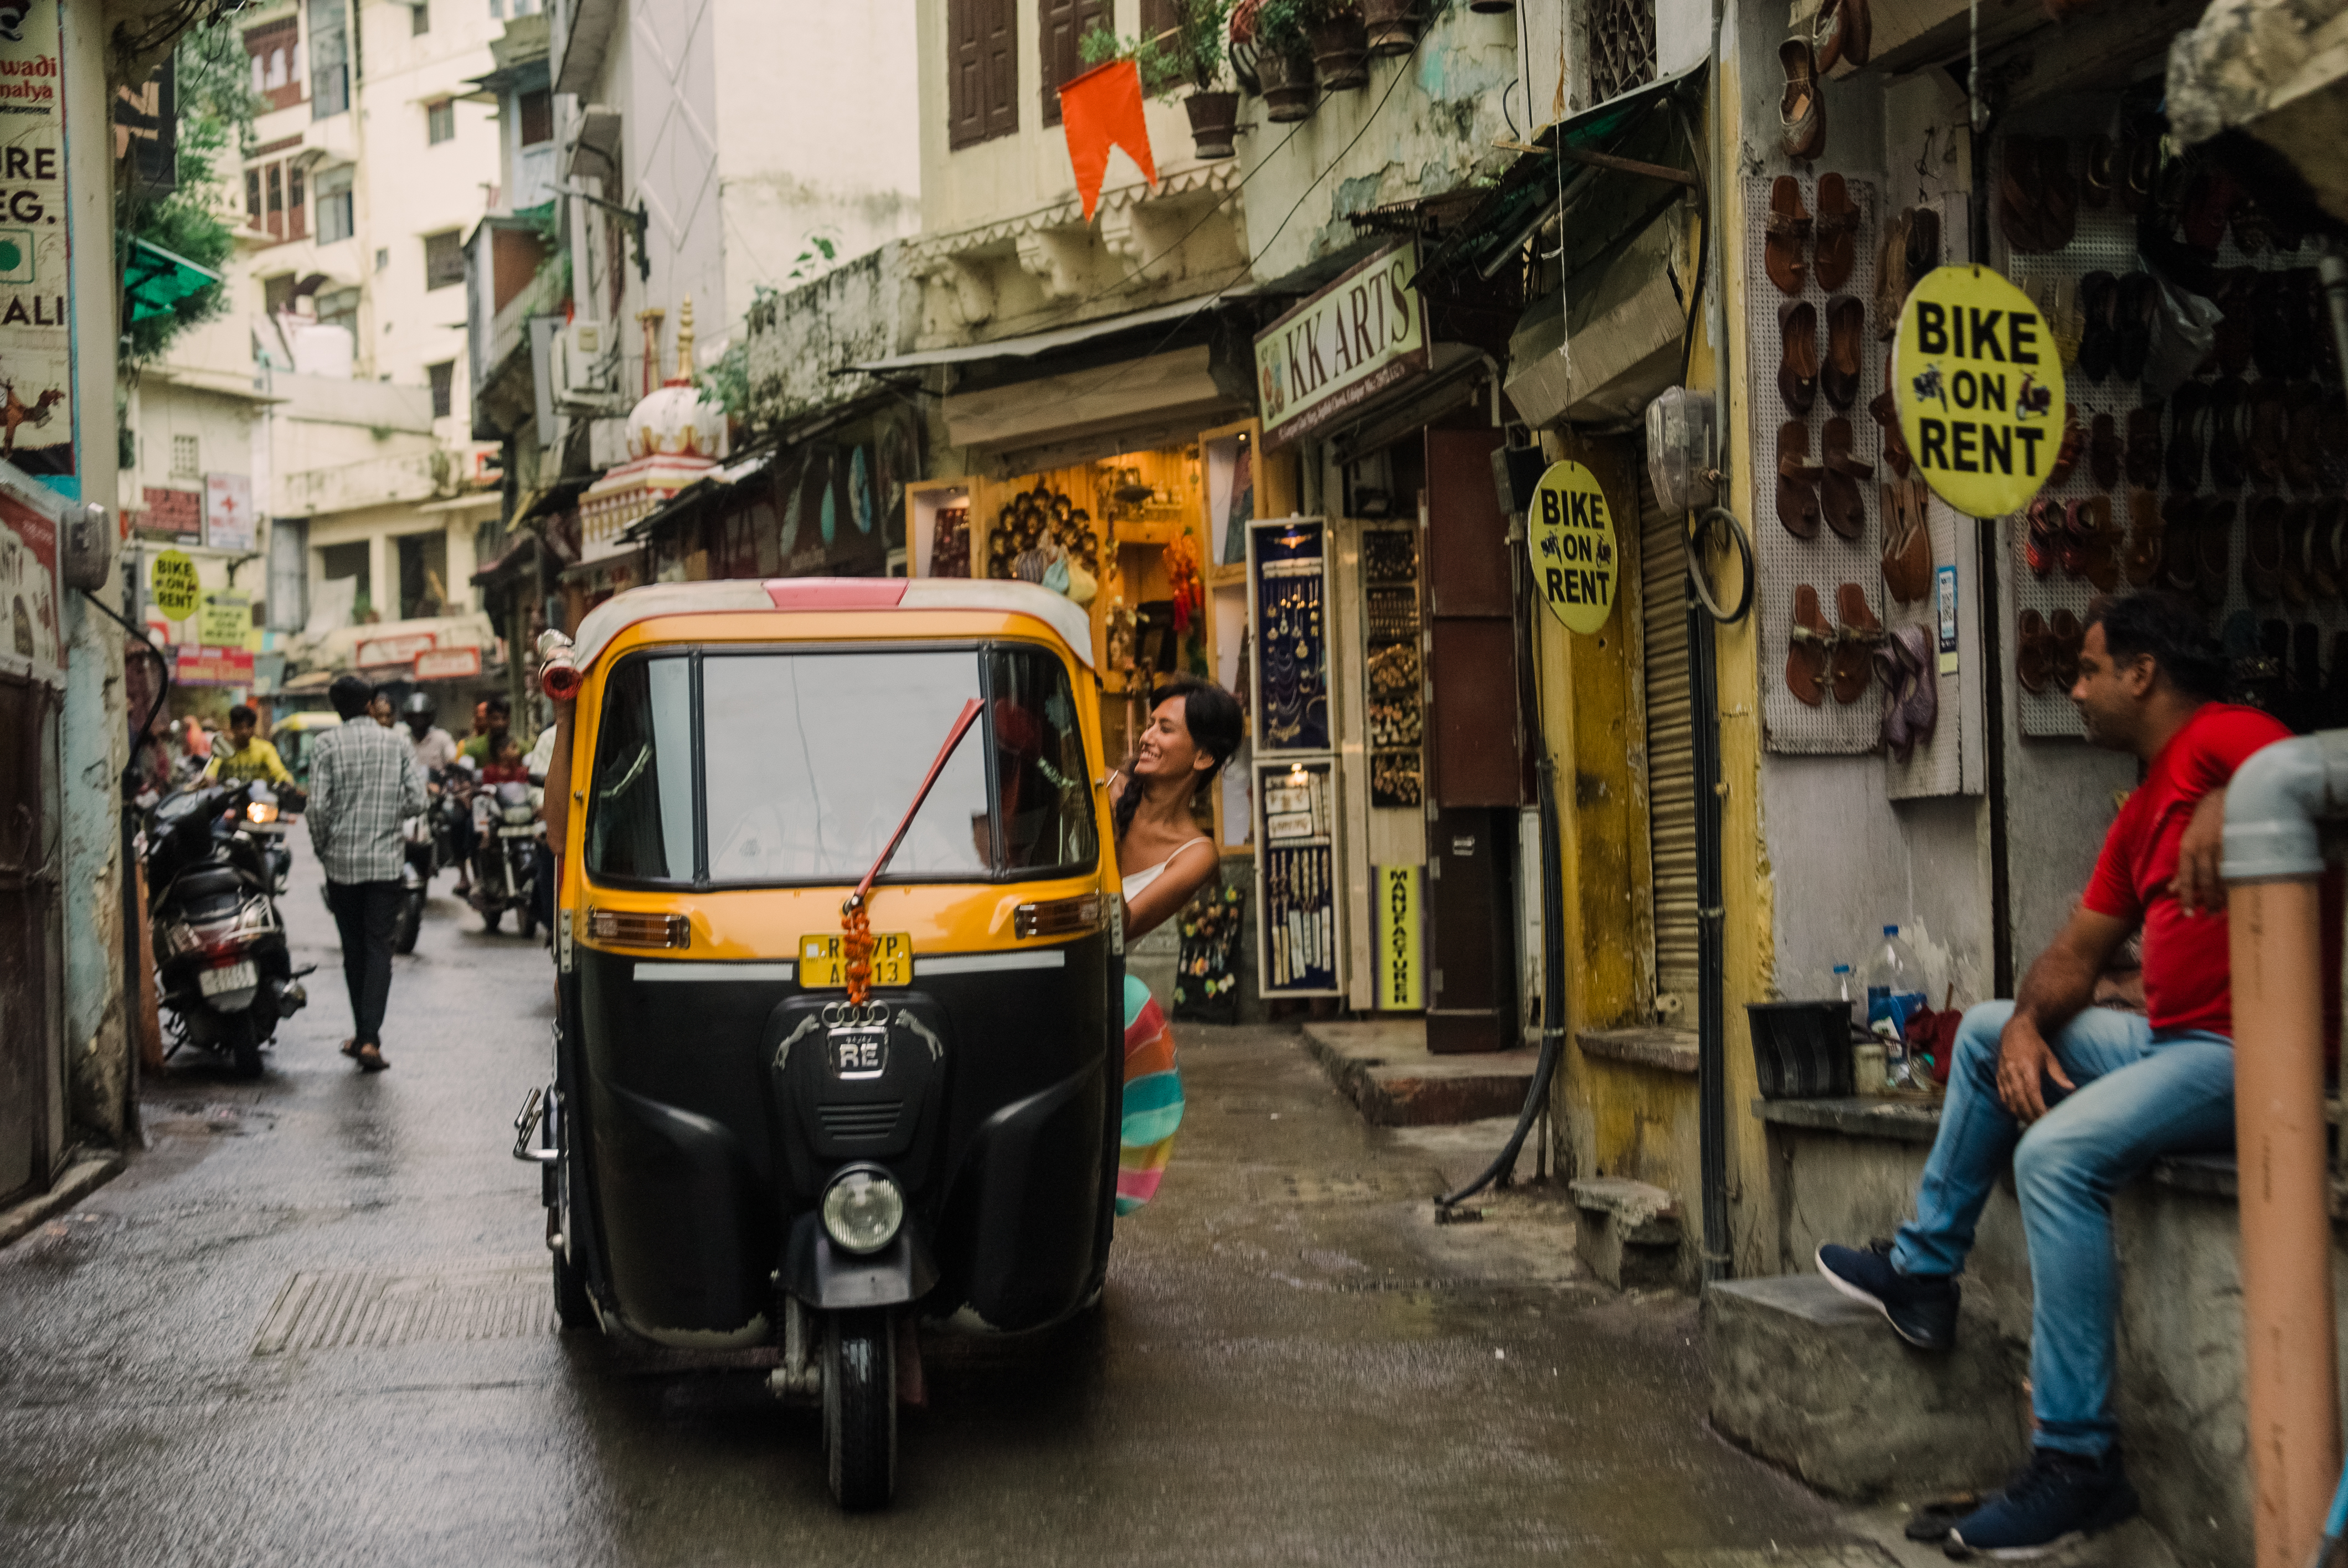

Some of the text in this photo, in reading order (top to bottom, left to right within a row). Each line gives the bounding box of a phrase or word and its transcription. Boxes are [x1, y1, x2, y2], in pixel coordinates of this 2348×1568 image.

[0, 146, 56, 180] RE
[1, 295, 64, 326] ALI
[1285, 310, 1329, 404] KK
[1333, 259, 1410, 379] ARTS
[1917, 300, 2040, 365] BIKE
[1951, 369, 2006, 411] ON
[1919, 417, 2045, 477] RENT
[1541, 488, 1605, 530] BIKE
[1563, 534, 1592, 563] ON
[157, 560, 192, 577] BIKE
[167, 578, 184, 589] ON
[1546, 567, 1609, 606] RENT
[158, 591, 192, 608] RENT
[1391, 870, 1407, 1004] MANUFACTURER
[840, 1043, 878, 1067] RE
